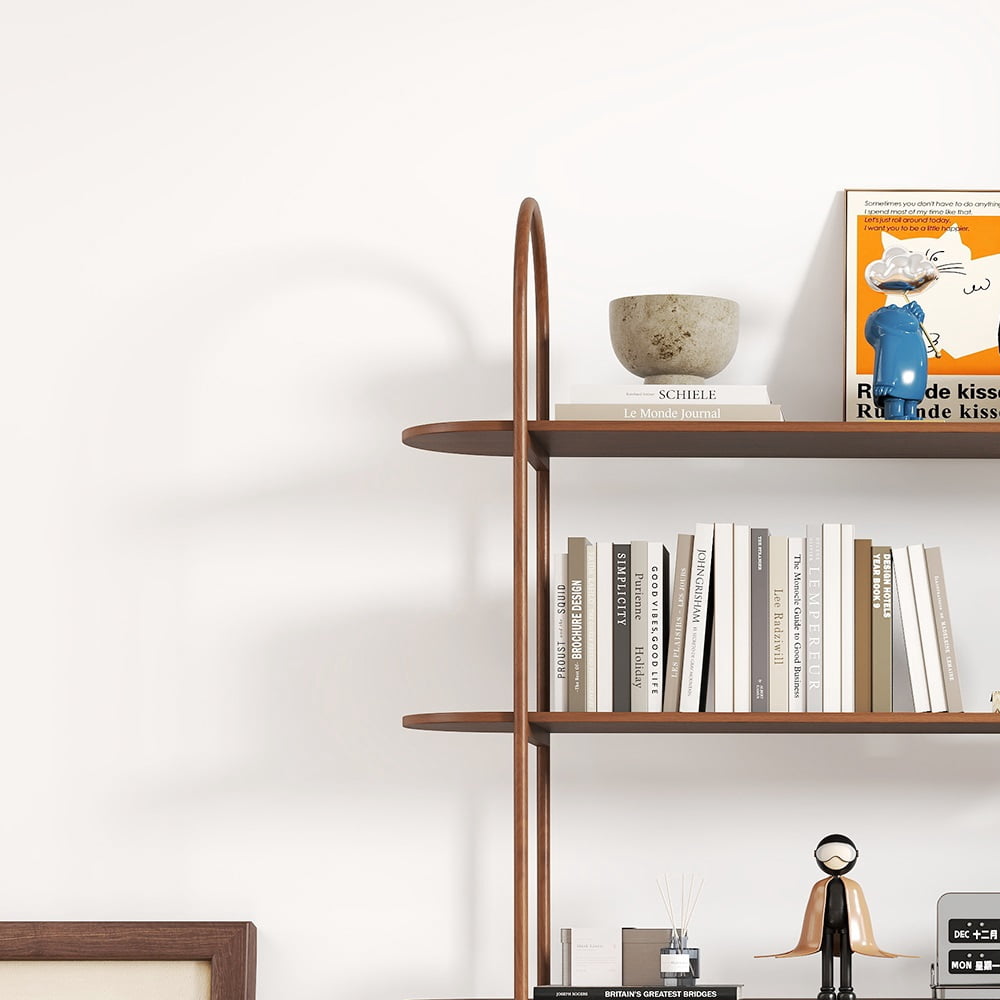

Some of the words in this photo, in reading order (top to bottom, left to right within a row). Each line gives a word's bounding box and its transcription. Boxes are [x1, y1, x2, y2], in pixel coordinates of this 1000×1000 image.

[659, 390, 716, 400] SCHIELE
[624, 408, 637, 418] Le
[640, 408, 678, 418] Monde
[680, 408, 721, 419] Journal
[856, 404, 952, 419] Runde
[794, 554, 802, 569] The
[872, 554, 880, 576] YEAR
[883, 554, 891, 584] DESIGN
[557, 584, 566, 614] SQUID
[572, 580, 582, 611] DESIGN
[616, 553, 626, 626] SIMPLICITY
[635, 574, 643, 620] Purienne
[774, 589, 783, 608] Lee
[794, 572, 802, 605] Monocle
[872, 578, 880, 601] BOOK
[883, 586, 891, 618] HOTELS
[794, 606, 802, 630] Guide
[572, 613, 582, 659] BROCHURE
[774, 612, 784, 665] Radziwill
[557, 641, 566, 679] PROUST
[633, 647, 644, 688] Holiday
[794, 641, 802, 664] Good
[794, 666, 802, 698] Business
[954, 930, 970, 939] DEC
[972, 930, 998, 940] 十二月
[951, 961, 972, 970] MON
